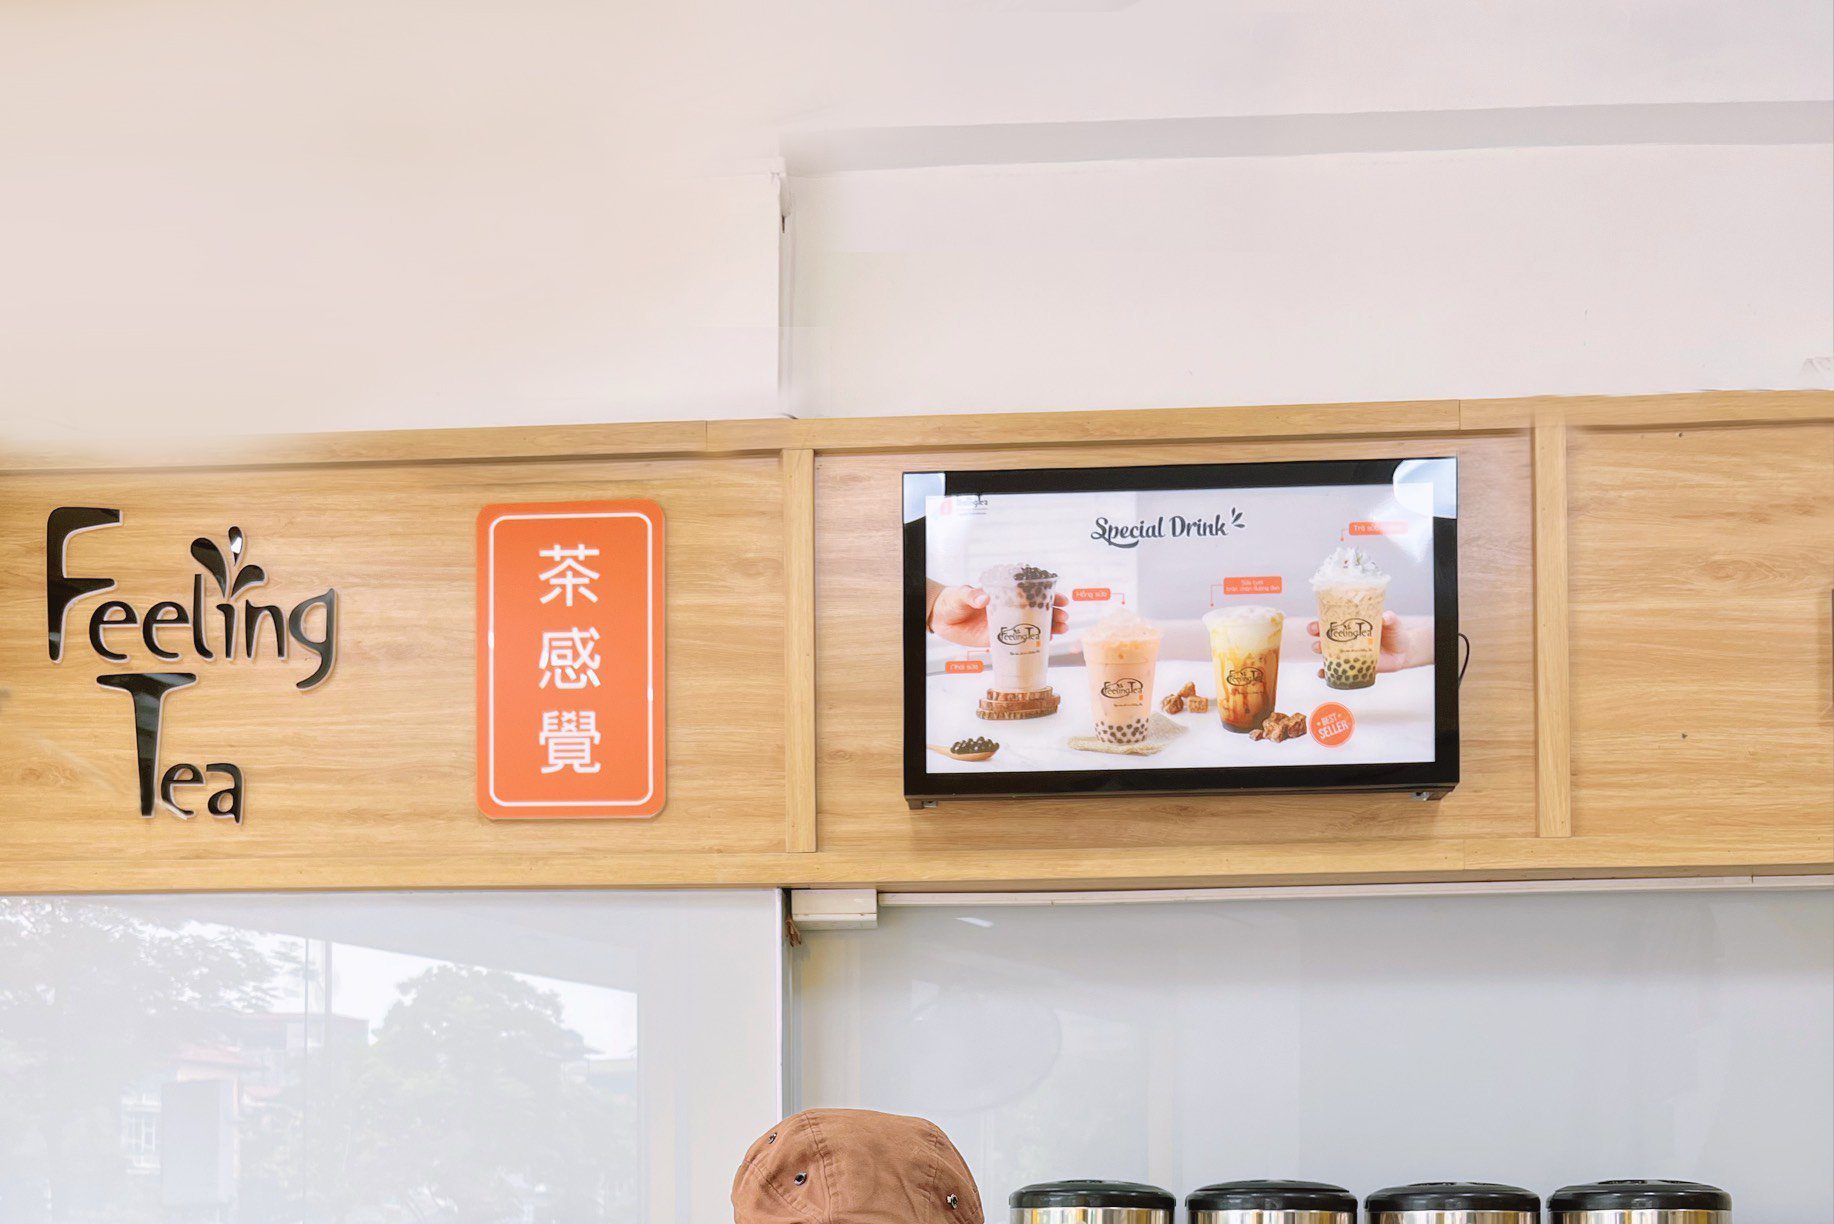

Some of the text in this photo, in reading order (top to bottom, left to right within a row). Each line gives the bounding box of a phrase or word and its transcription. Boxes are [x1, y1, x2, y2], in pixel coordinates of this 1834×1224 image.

[1091, 514, 1228, 548] Special Drink
[46, 506, 339, 692] Feeling
[537, 543, 602, 776] 茶感覺
[96, 672, 245, 825] Tea
[1318, 719, 1349, 739] SELLER
[1321, 712, 1338, 725] BEST
